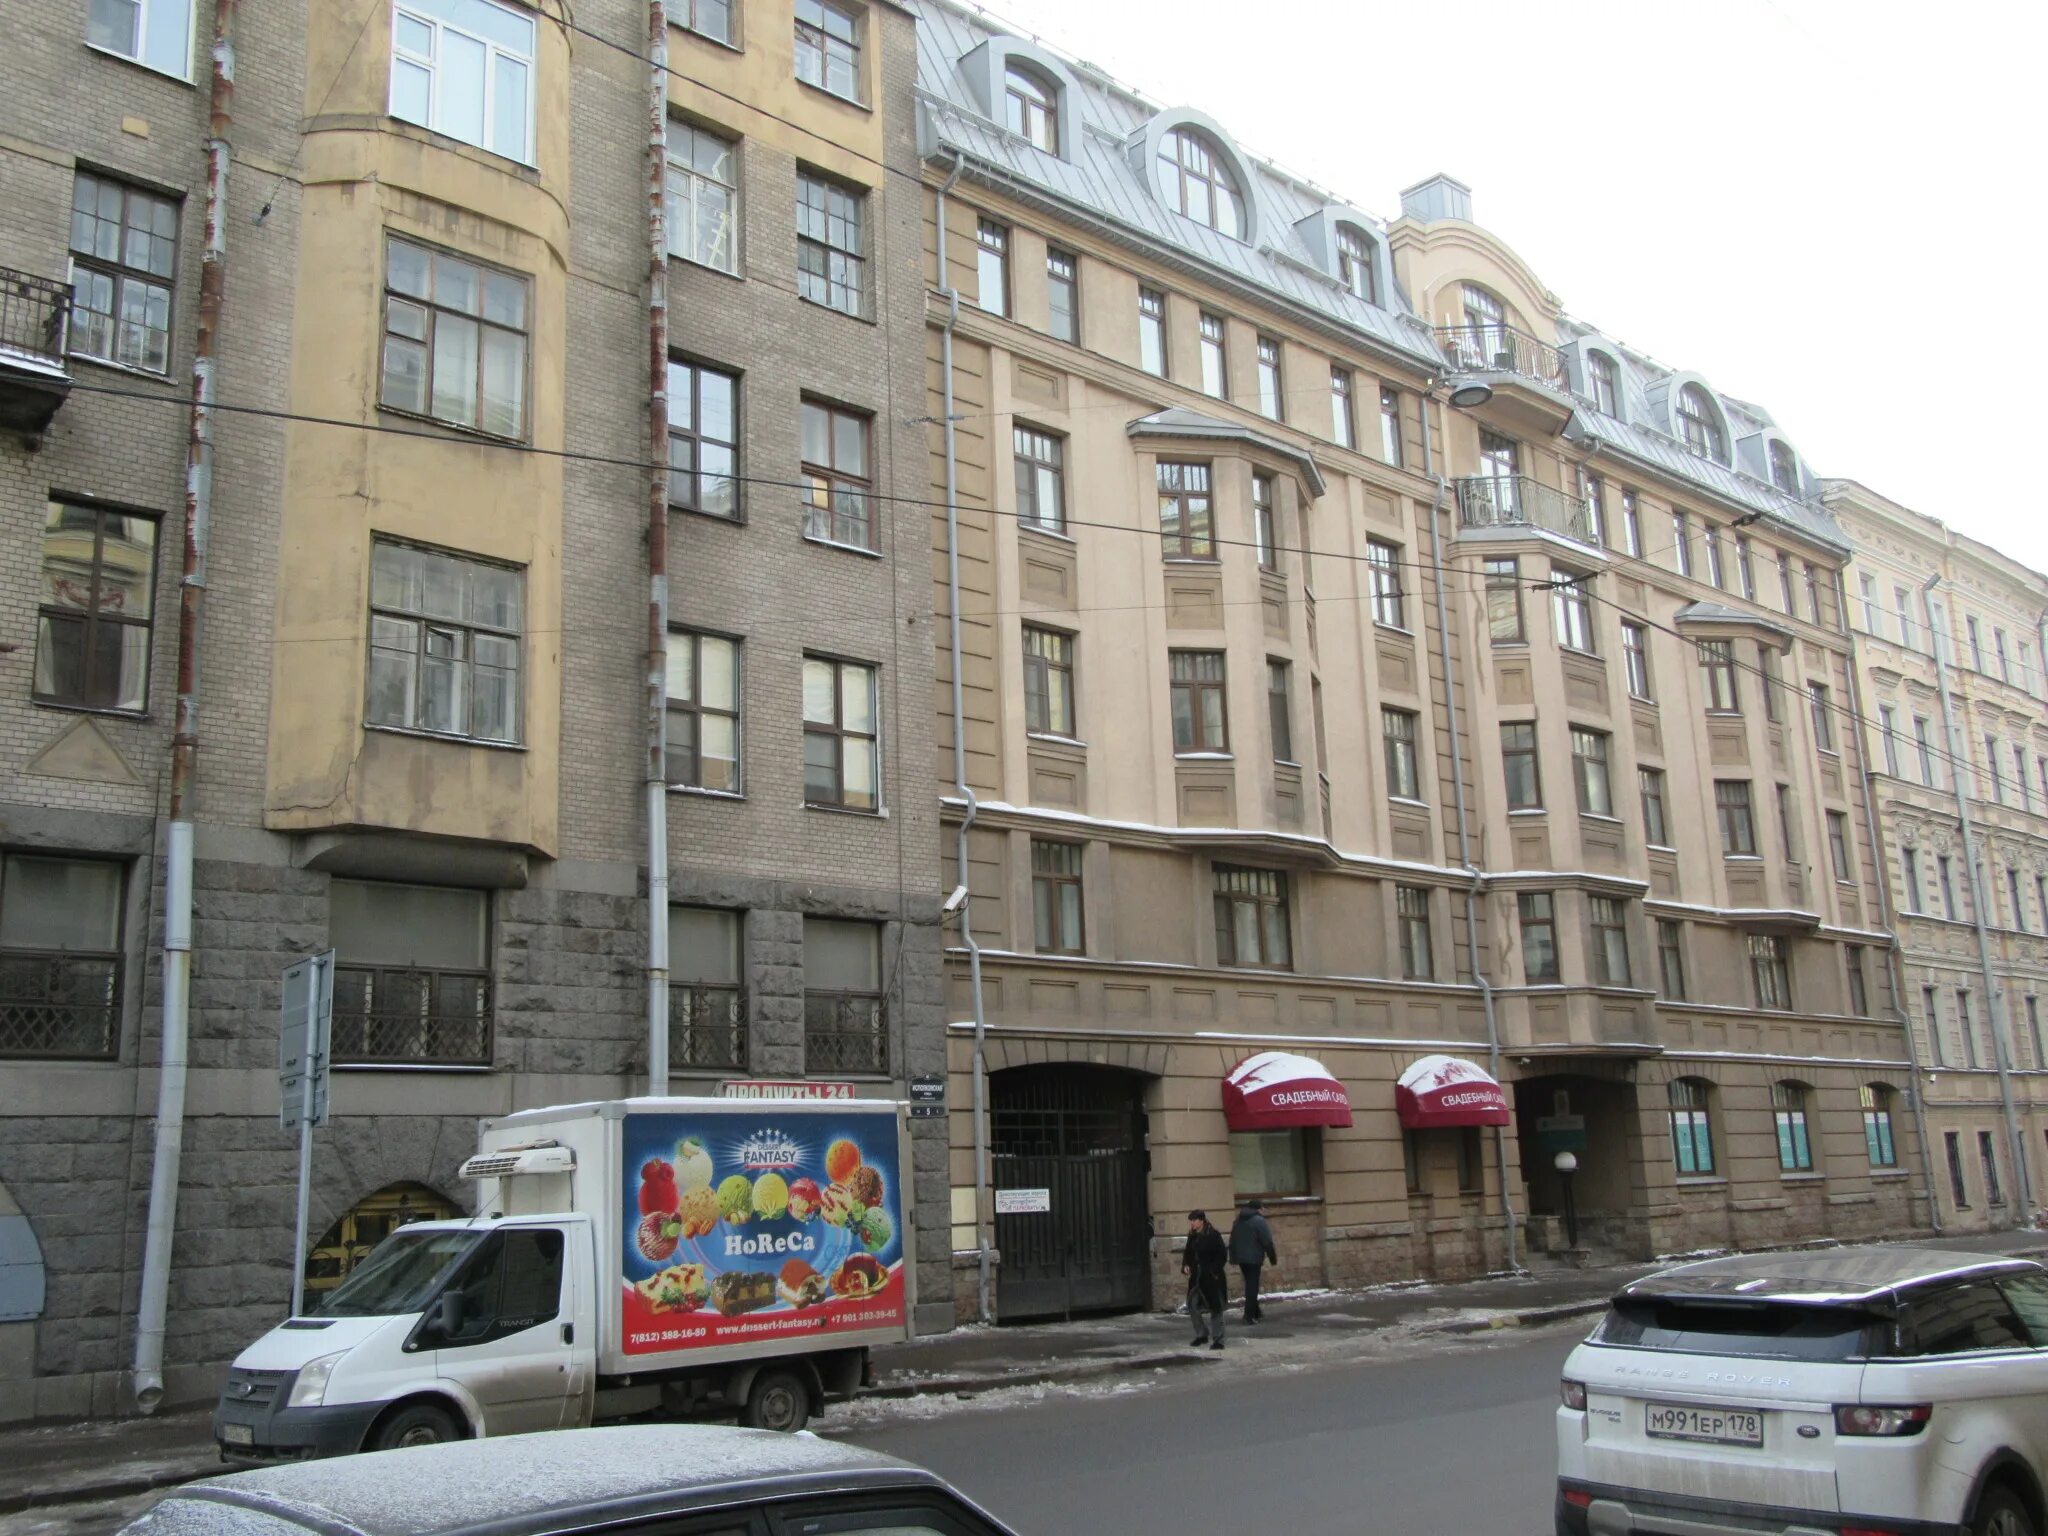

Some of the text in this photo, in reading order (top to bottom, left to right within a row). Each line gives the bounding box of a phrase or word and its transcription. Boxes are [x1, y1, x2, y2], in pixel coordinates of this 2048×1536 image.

[826, 1086, 850, 1099] 24
[1271, 1089, 1331, 1106] СВАДЕБНЫЙ
[1441, 1091, 1493, 1106] СВАДЕБНЫЙ
[757, 1143, 782, 1151] DESSERT
[743, 1151, 796, 1163] FANTASY
[724, 1231, 815, 1256] HoReCa
[499, 1319, 534, 1328] TRANSIT
[630, 1331, 660, 1345] 7(812)
[831, 1314, 841, 1323] +7
[1615, 1366, 1792, 1386] RANGE ROVER
[1728, 1415, 1756, 1432] 178
